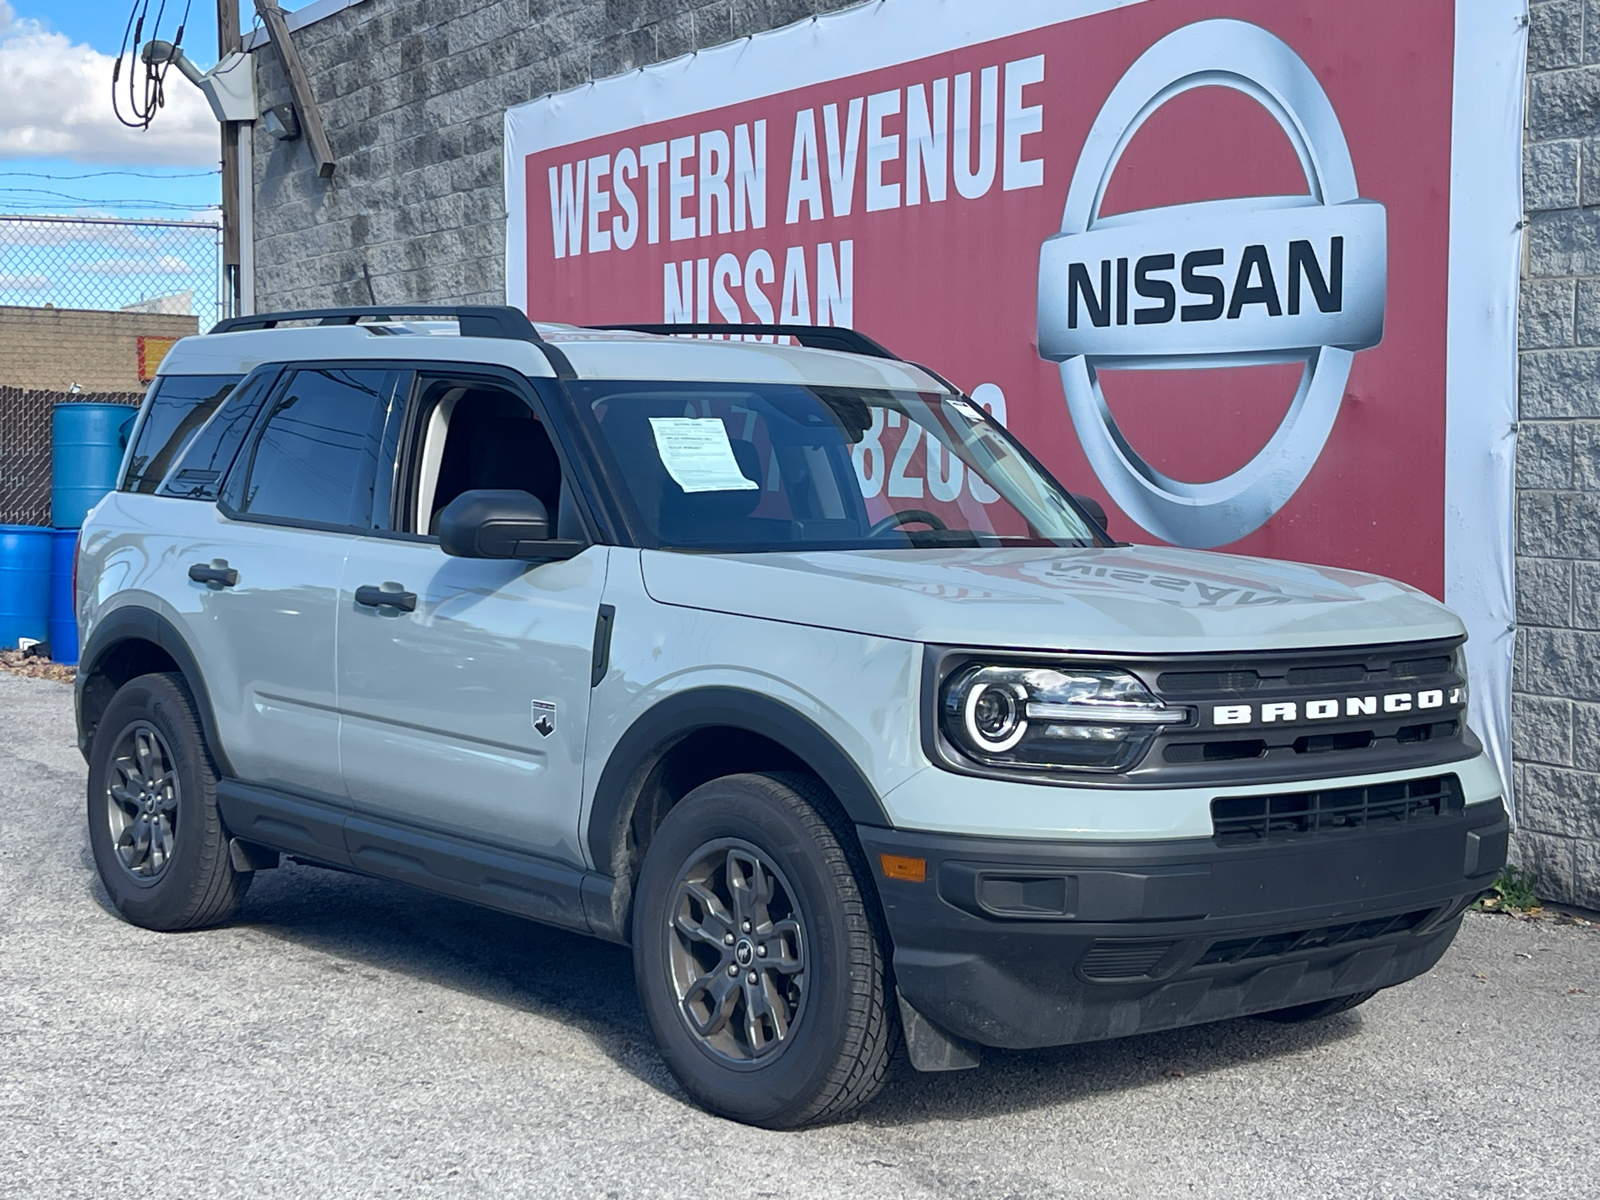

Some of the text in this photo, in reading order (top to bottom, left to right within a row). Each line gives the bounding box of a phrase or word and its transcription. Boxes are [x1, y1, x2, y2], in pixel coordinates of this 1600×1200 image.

[548, 54, 1045, 259] WESTERN AVENUE
[664, 239, 853, 345] NISSAN
[1067, 236, 1344, 329] NISSAN
[1213, 688, 1444, 726] BRONCO
